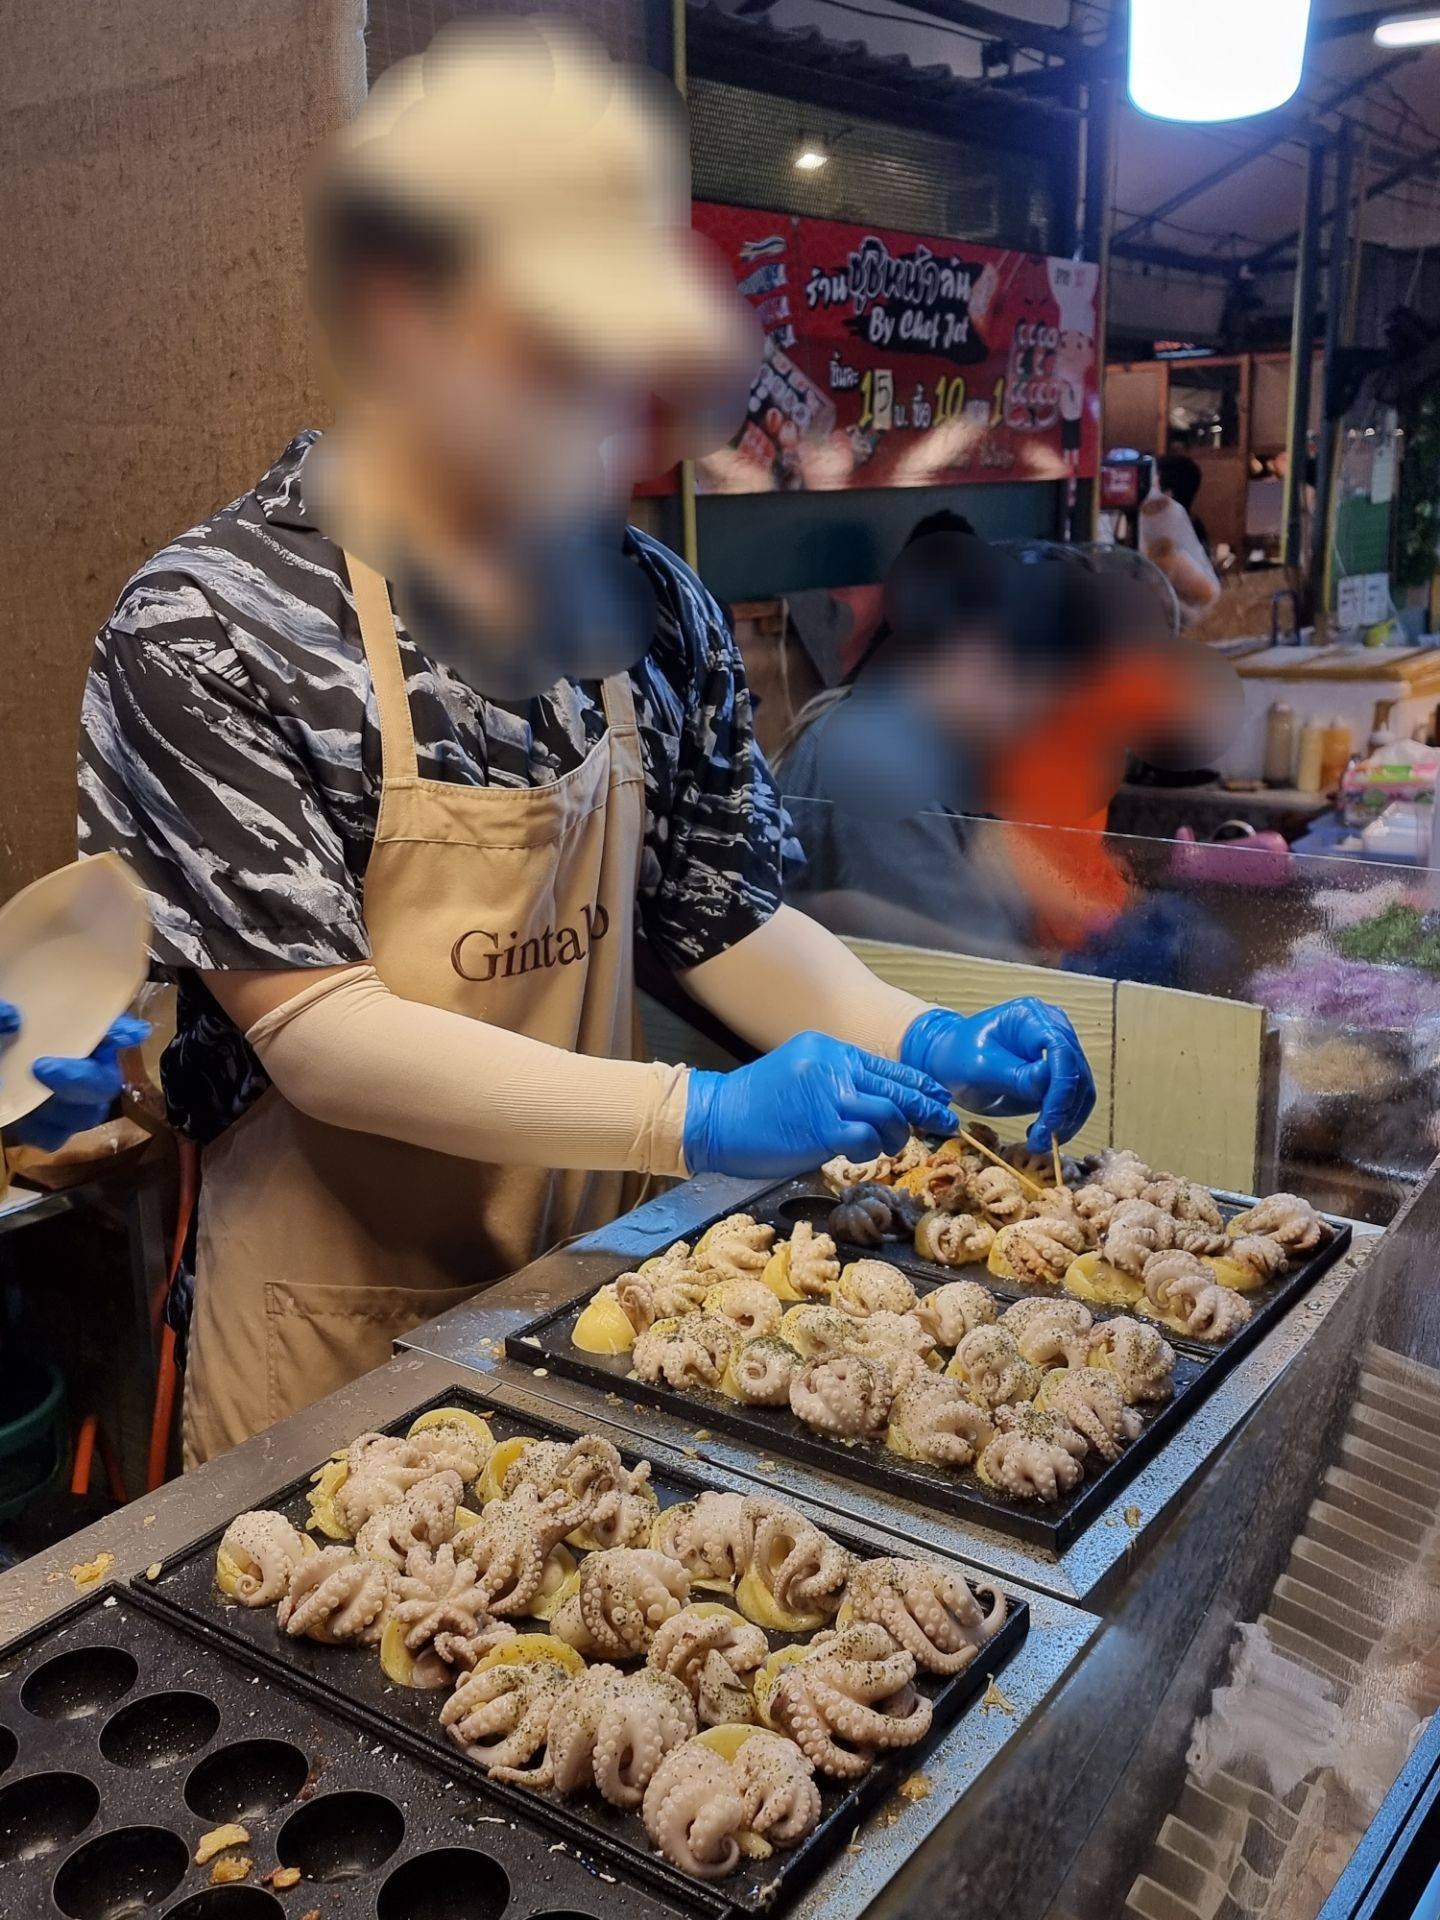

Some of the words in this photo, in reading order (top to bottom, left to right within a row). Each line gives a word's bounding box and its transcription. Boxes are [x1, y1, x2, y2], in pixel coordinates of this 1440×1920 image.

[869, 306, 895, 345] By
[899, 309, 939, 348] Chef
[859, 368, 892, 428] 15
[932, 376, 965, 428] 10
